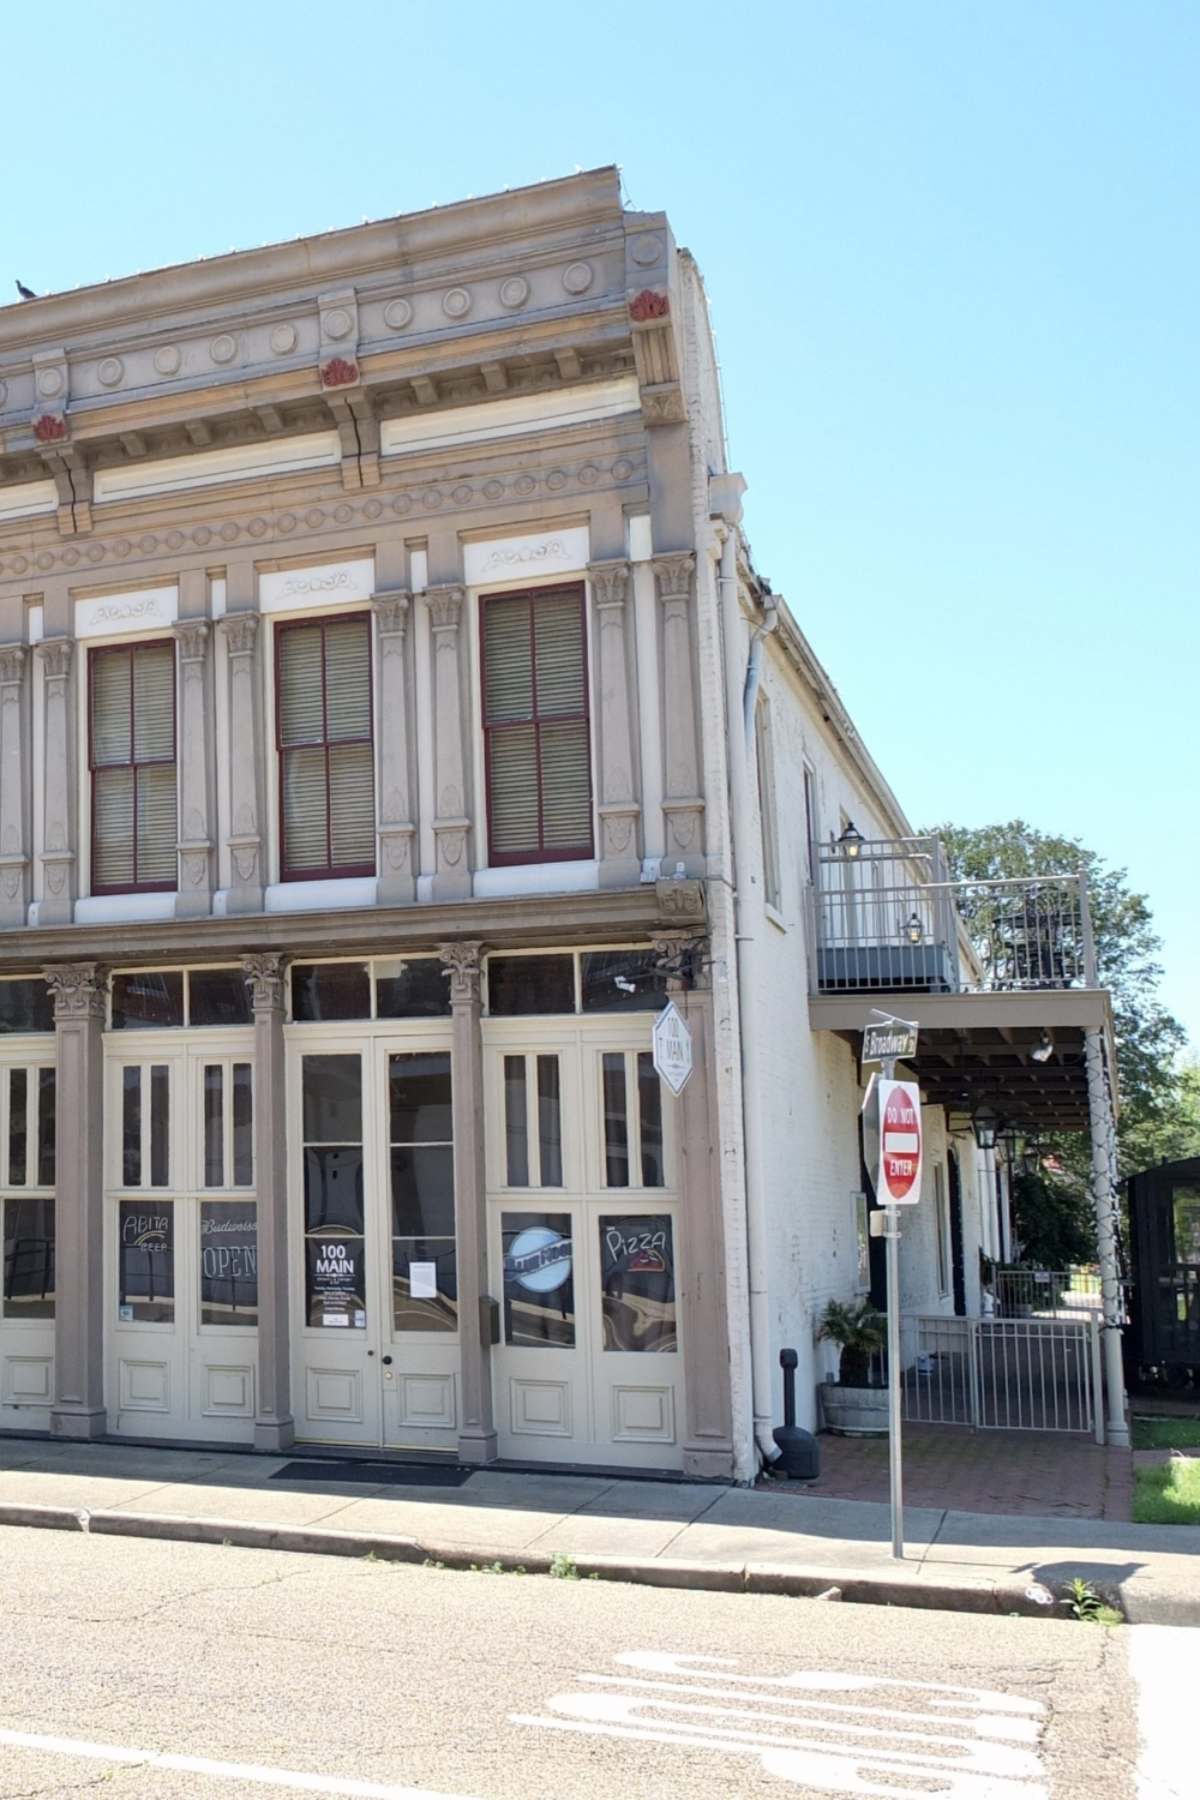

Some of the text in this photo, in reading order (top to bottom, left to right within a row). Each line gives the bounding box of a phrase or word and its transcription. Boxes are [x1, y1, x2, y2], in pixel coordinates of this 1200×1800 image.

[870, 1031, 909, 1056] Broadway
[887, 1106, 914, 1125] DO NOT
[890, 1159, 912, 1177] ENTER
[123, 1216, 168, 1241] ABITA
[203, 1245, 257, 1278] OPEN
[321, 1245, 346, 1259] 100
[316, 1259, 354, 1273] MAIN
